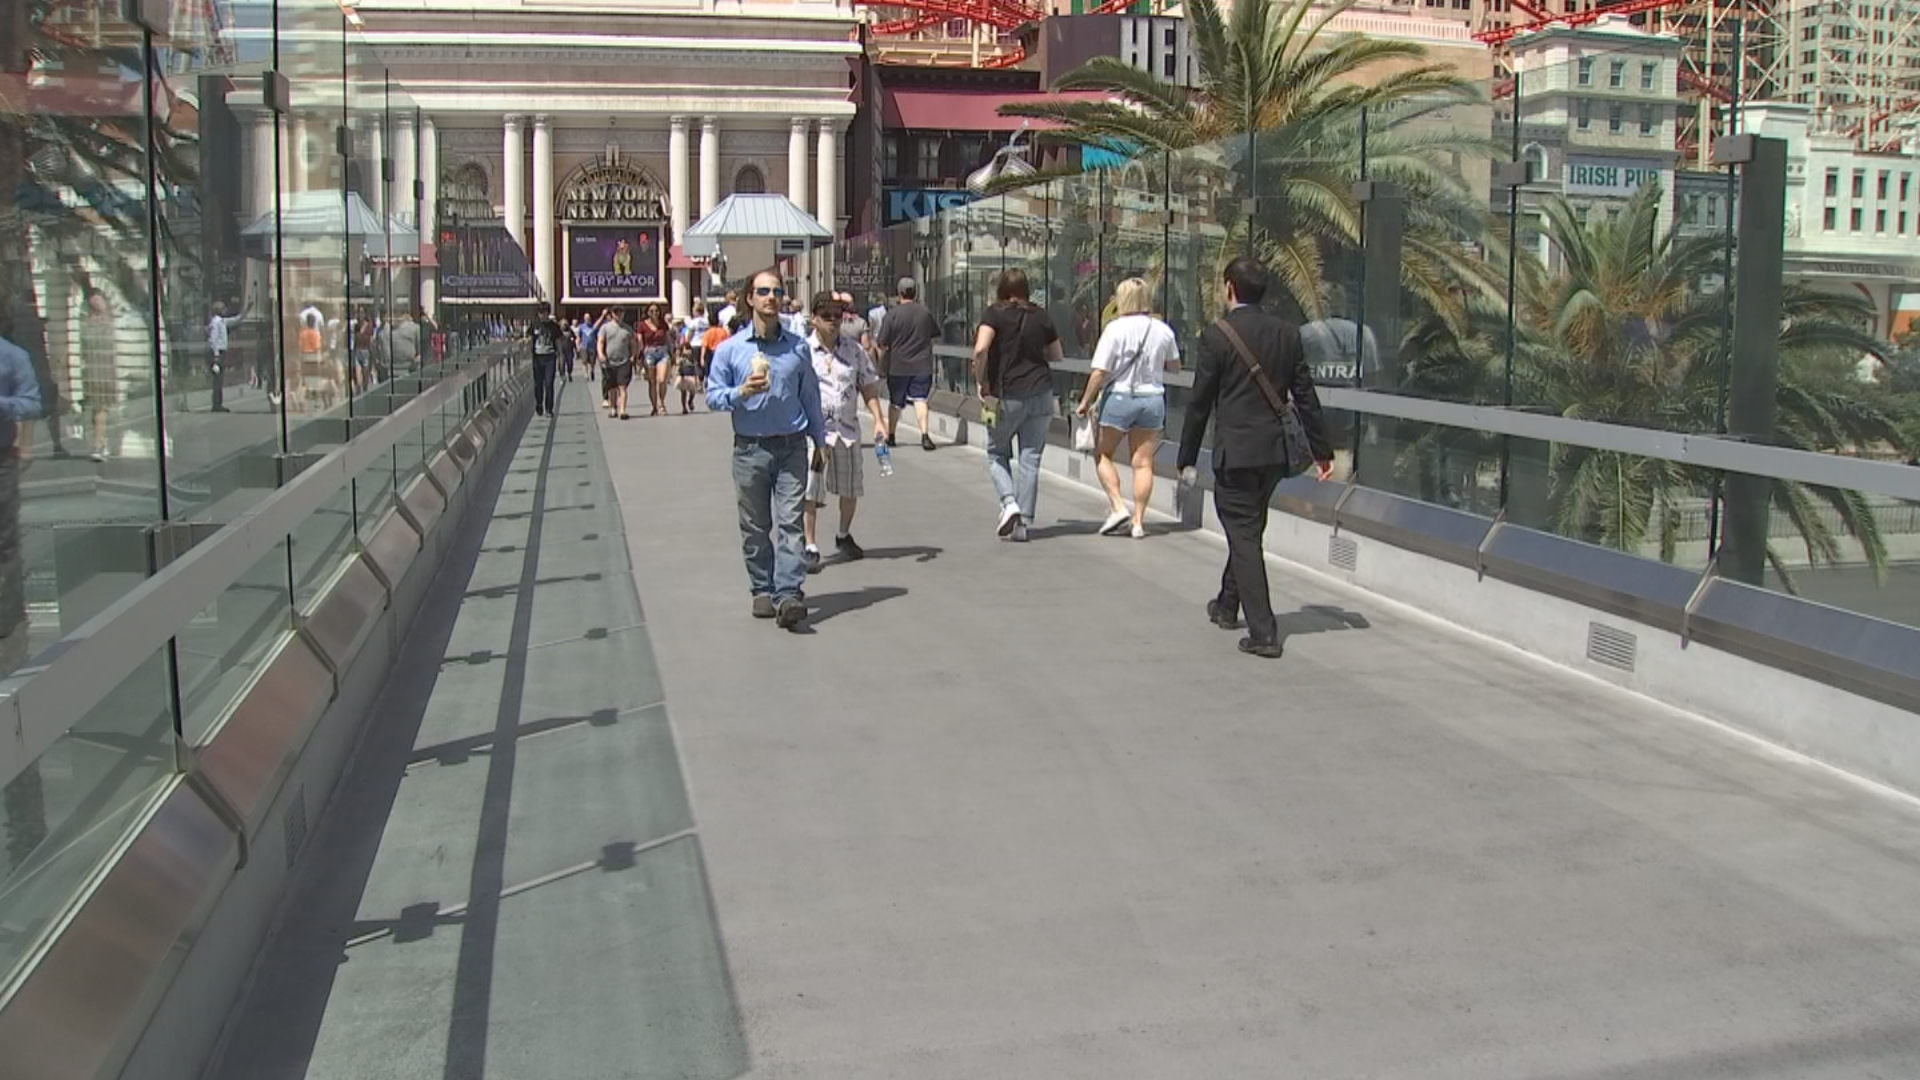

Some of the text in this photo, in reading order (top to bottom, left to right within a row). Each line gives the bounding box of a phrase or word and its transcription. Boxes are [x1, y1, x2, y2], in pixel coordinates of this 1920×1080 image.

[1569, 164, 1660, 189] IRISH PUB
[566, 183, 661, 201] NEW YORK
[566, 202, 661, 219] NEW YORK
[573, 274, 656, 288] TERRY FATOR
